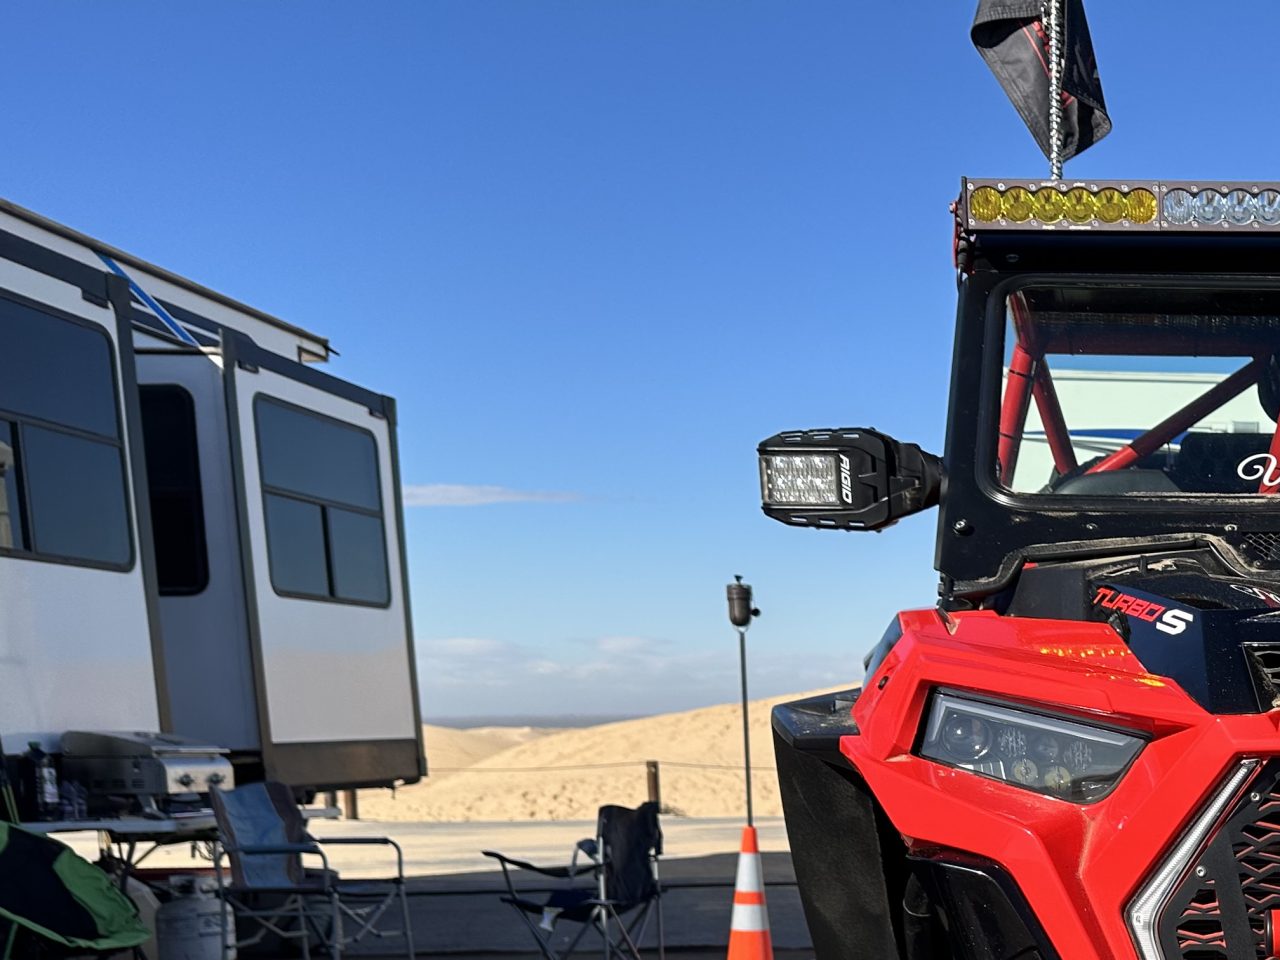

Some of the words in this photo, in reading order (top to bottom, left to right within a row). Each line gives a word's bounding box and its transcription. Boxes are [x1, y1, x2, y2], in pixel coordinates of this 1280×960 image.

[838, 453, 852, 504] RIGID
[1092, 587, 1166, 623] TURBO
[1156, 608, 1194, 636] S
